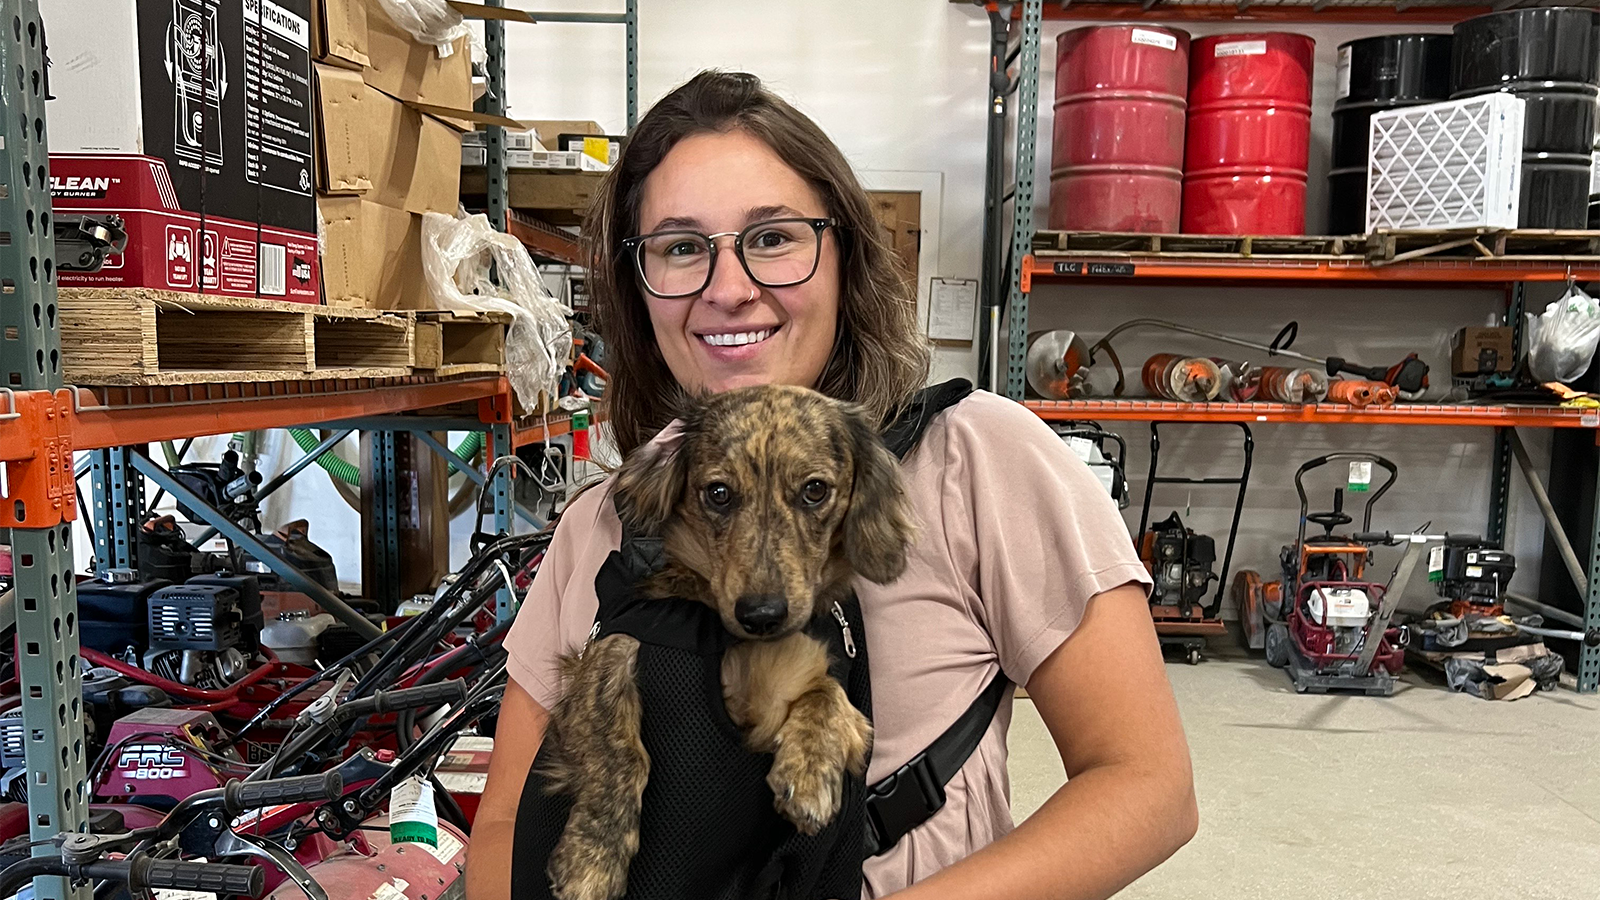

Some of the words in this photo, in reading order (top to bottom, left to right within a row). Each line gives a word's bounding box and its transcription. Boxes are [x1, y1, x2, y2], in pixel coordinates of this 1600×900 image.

[245, 0, 300, 35] SPEIFICATIONS
[301, 269, 311, 280] USA
[135, 768, 173, 780] 800
